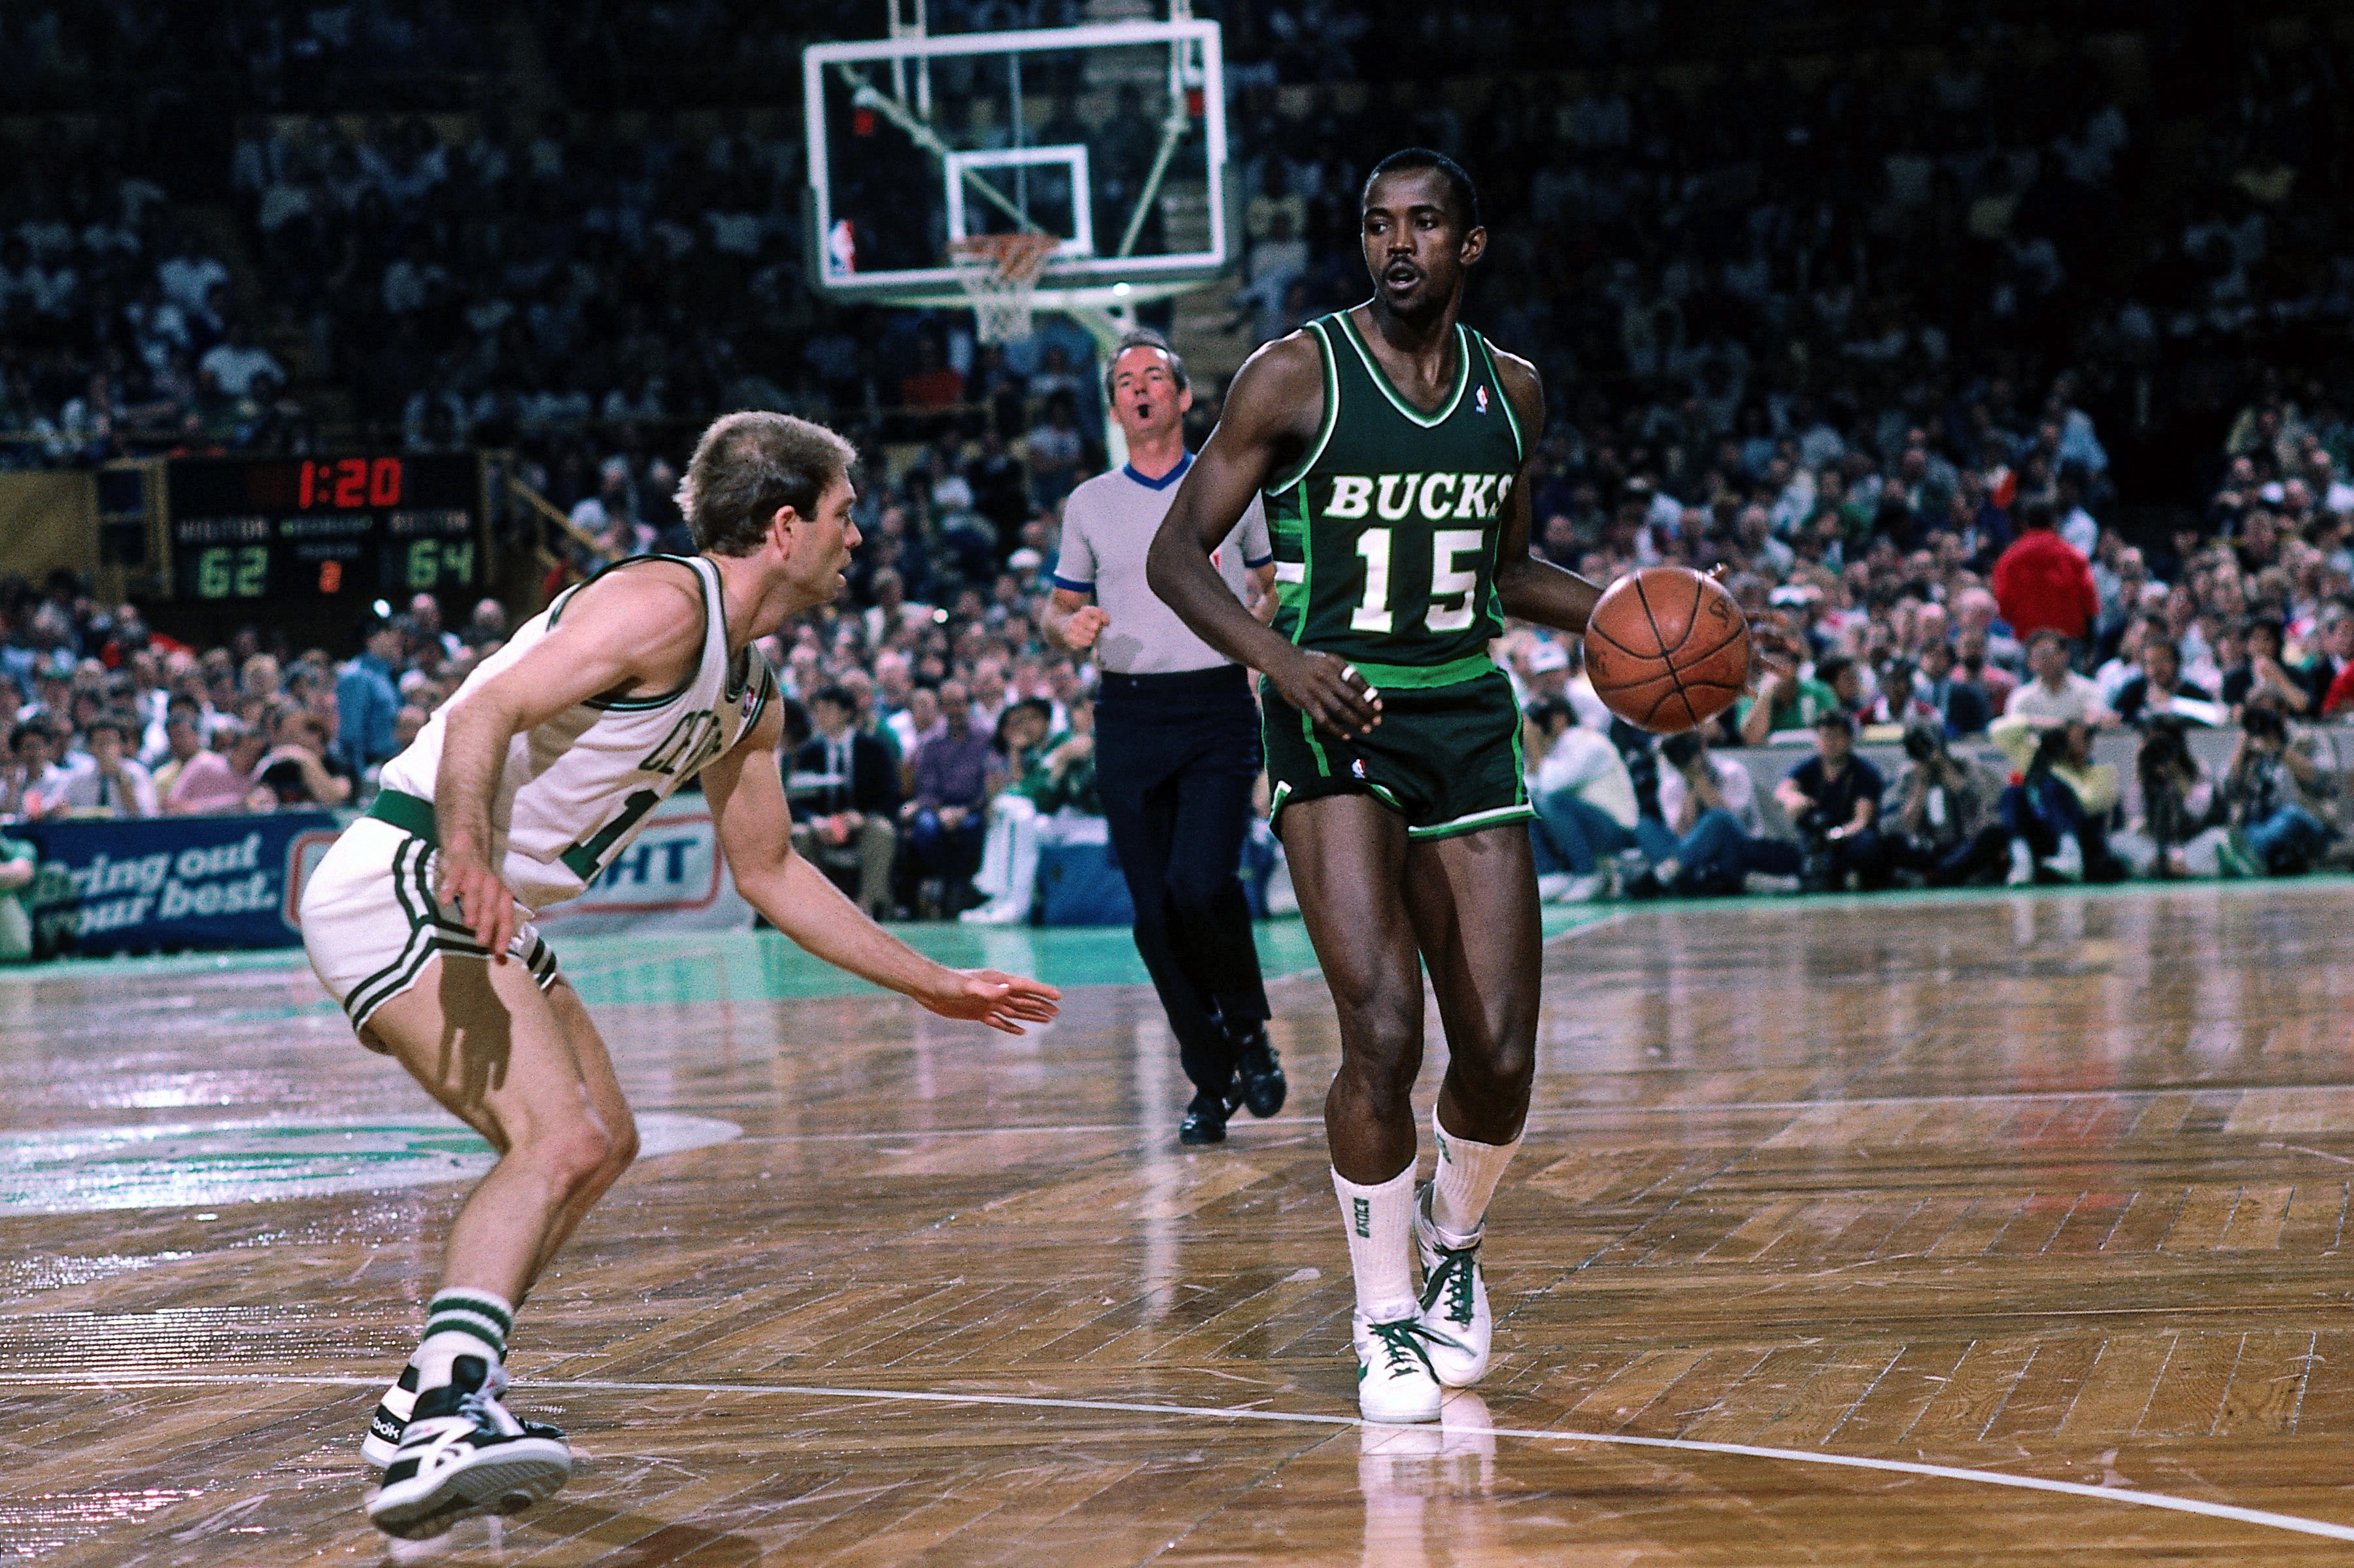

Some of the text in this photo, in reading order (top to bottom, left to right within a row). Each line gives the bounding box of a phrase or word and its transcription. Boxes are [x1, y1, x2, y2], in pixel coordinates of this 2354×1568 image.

[299, 459, 402, 509] 1:20
[199, 545, 268, 598] 62
[407, 537, 474, 588] 64
[1350, 527, 1484, 634] 15
[175, 831, 262, 879] out
[590, 838, 700, 888] HT
[160, 872, 278, 919] best.
